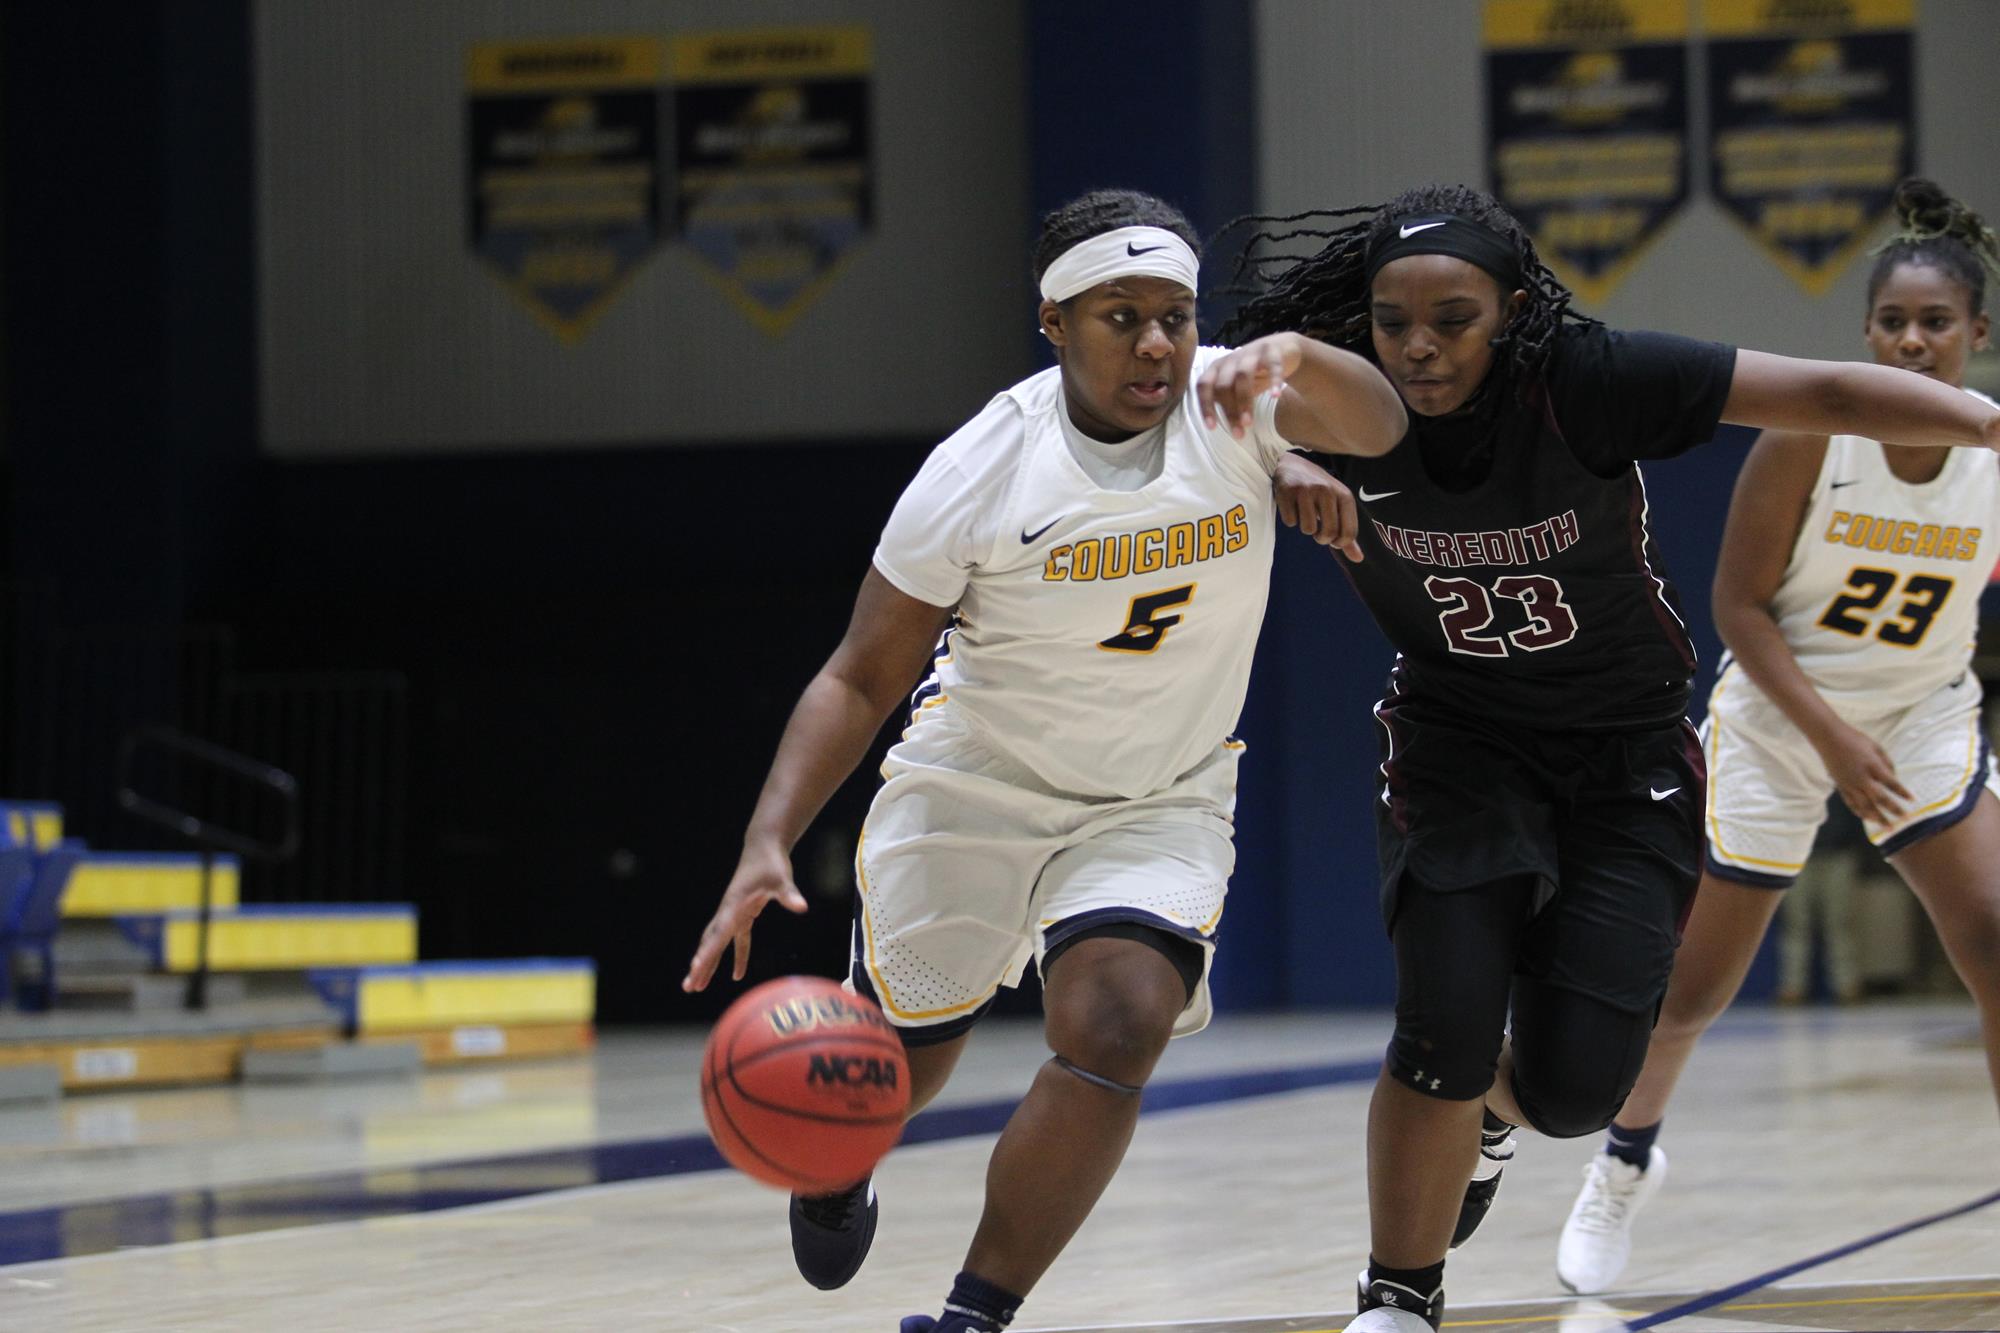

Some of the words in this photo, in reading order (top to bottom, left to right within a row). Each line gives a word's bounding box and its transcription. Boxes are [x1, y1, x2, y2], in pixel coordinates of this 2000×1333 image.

[1042, 504, 1249, 582] COUGARS
[1371, 509, 1580, 567] MEREDITH
[1824, 511, 1982, 561] COUGARS
[1423, 574, 1579, 657] 23
[1815, 564, 1955, 650] 23
[807, 1054, 897, 1089] NCAA
